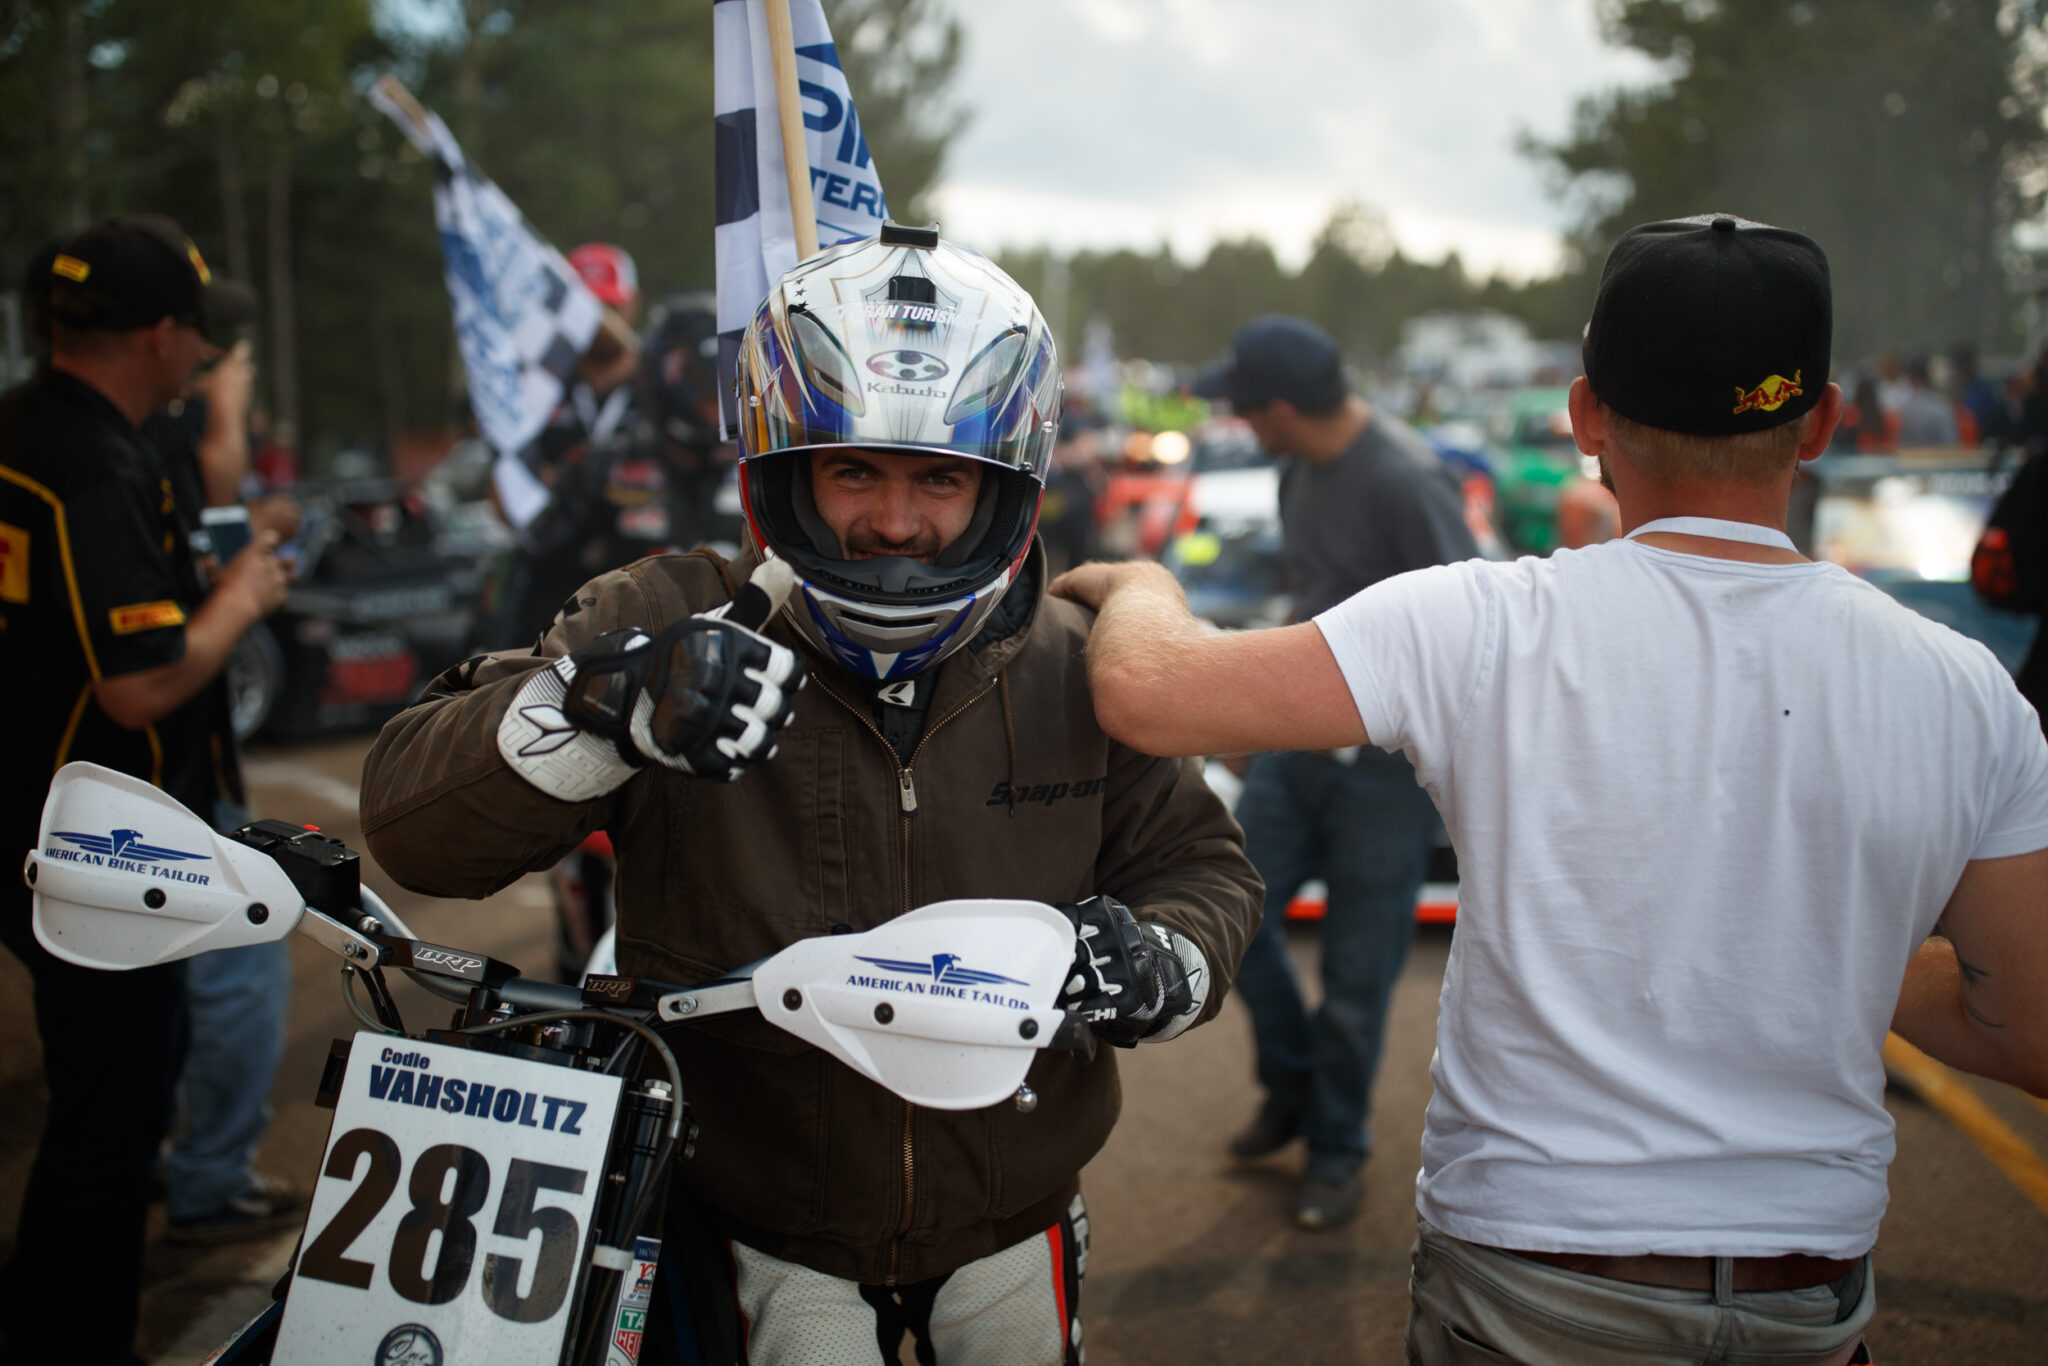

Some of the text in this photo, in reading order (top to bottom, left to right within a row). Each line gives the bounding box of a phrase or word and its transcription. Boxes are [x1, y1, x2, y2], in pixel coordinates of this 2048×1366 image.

[107, 858, 147, 875] BIKE
[151, 865, 210, 886] TAILOR
[415, 947, 482, 973] BRP
[586, 977, 632, 998] BRP
[846, 975, 1030, 1011] AMERICAN BIKE TAILOR
[369, 1064, 588, 1136] VAHSHOLTZ
[297, 1127, 588, 1324] 285
